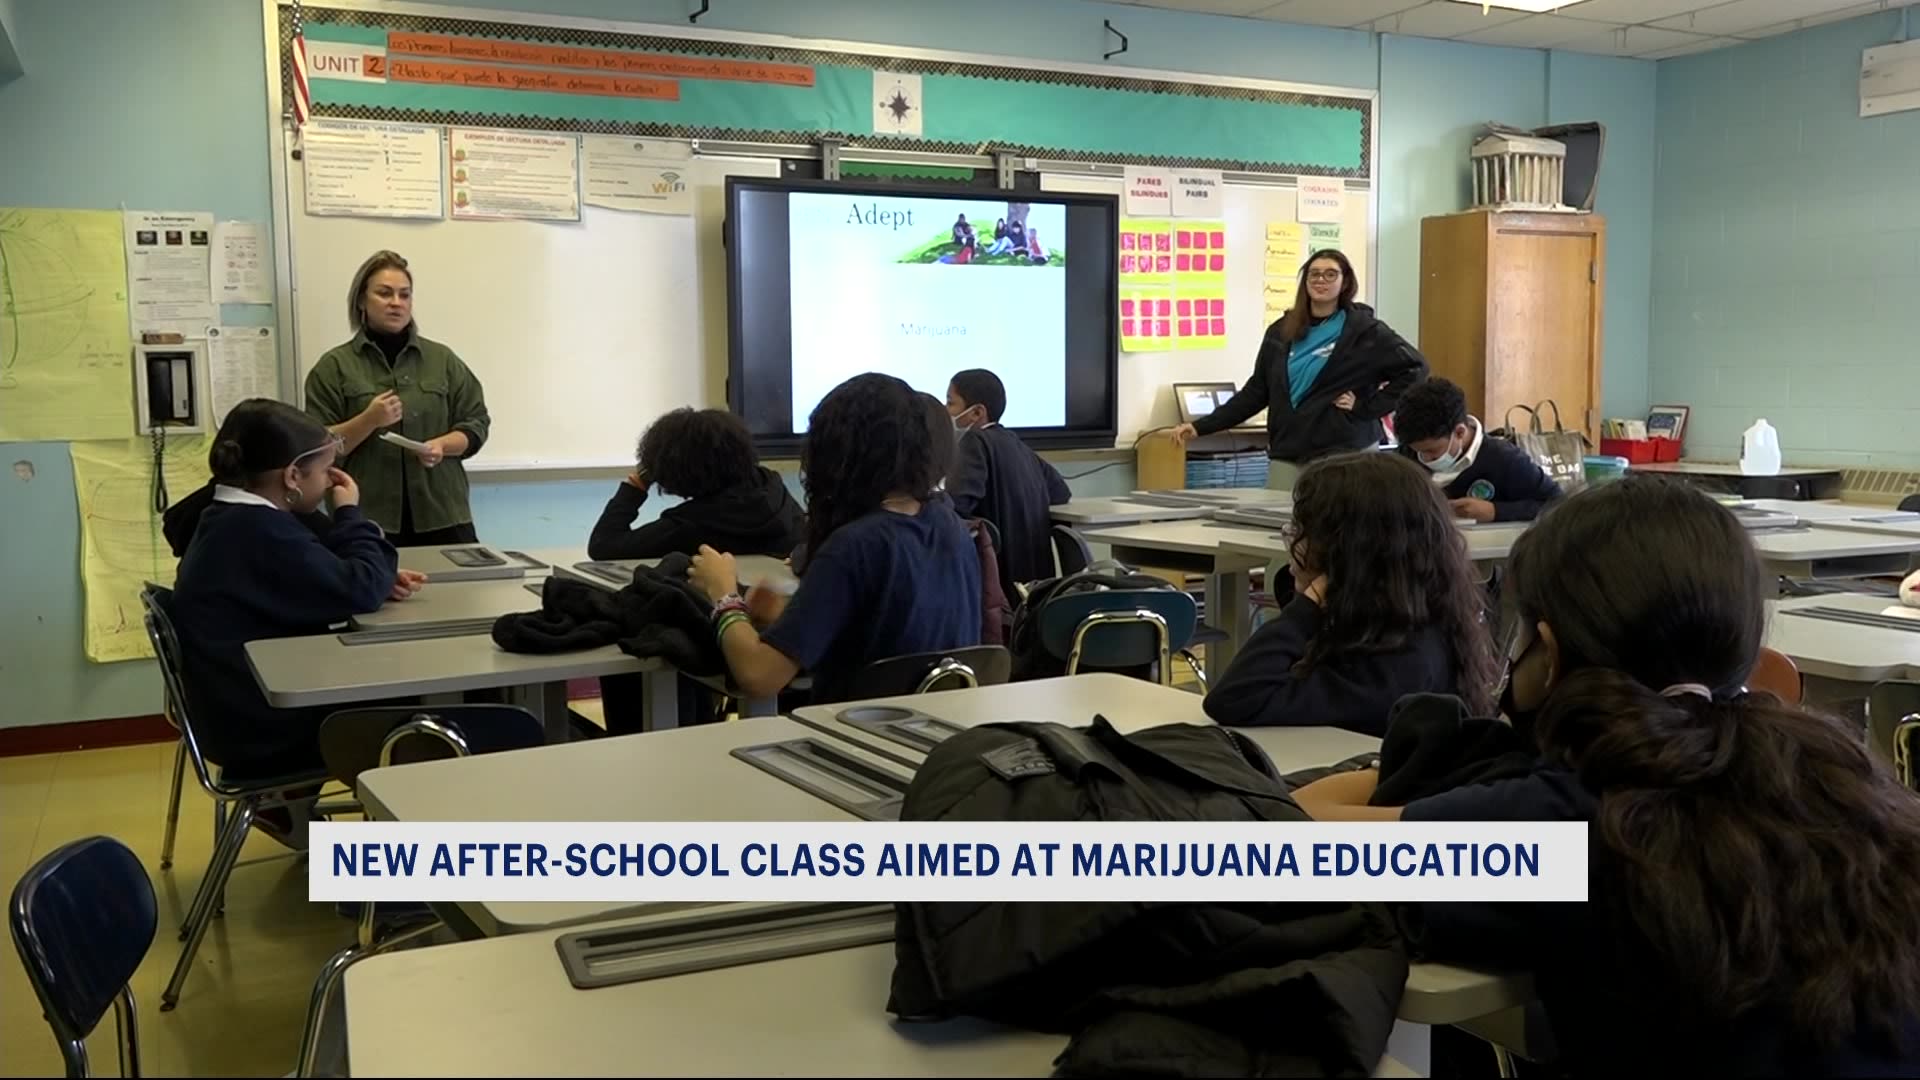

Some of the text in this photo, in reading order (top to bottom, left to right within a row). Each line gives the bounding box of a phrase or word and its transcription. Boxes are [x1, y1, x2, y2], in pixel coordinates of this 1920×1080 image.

[313, 55, 384, 75] UNIT 2
[847, 203, 914, 231] Adept
[901, 322, 967, 338] Marijuana
